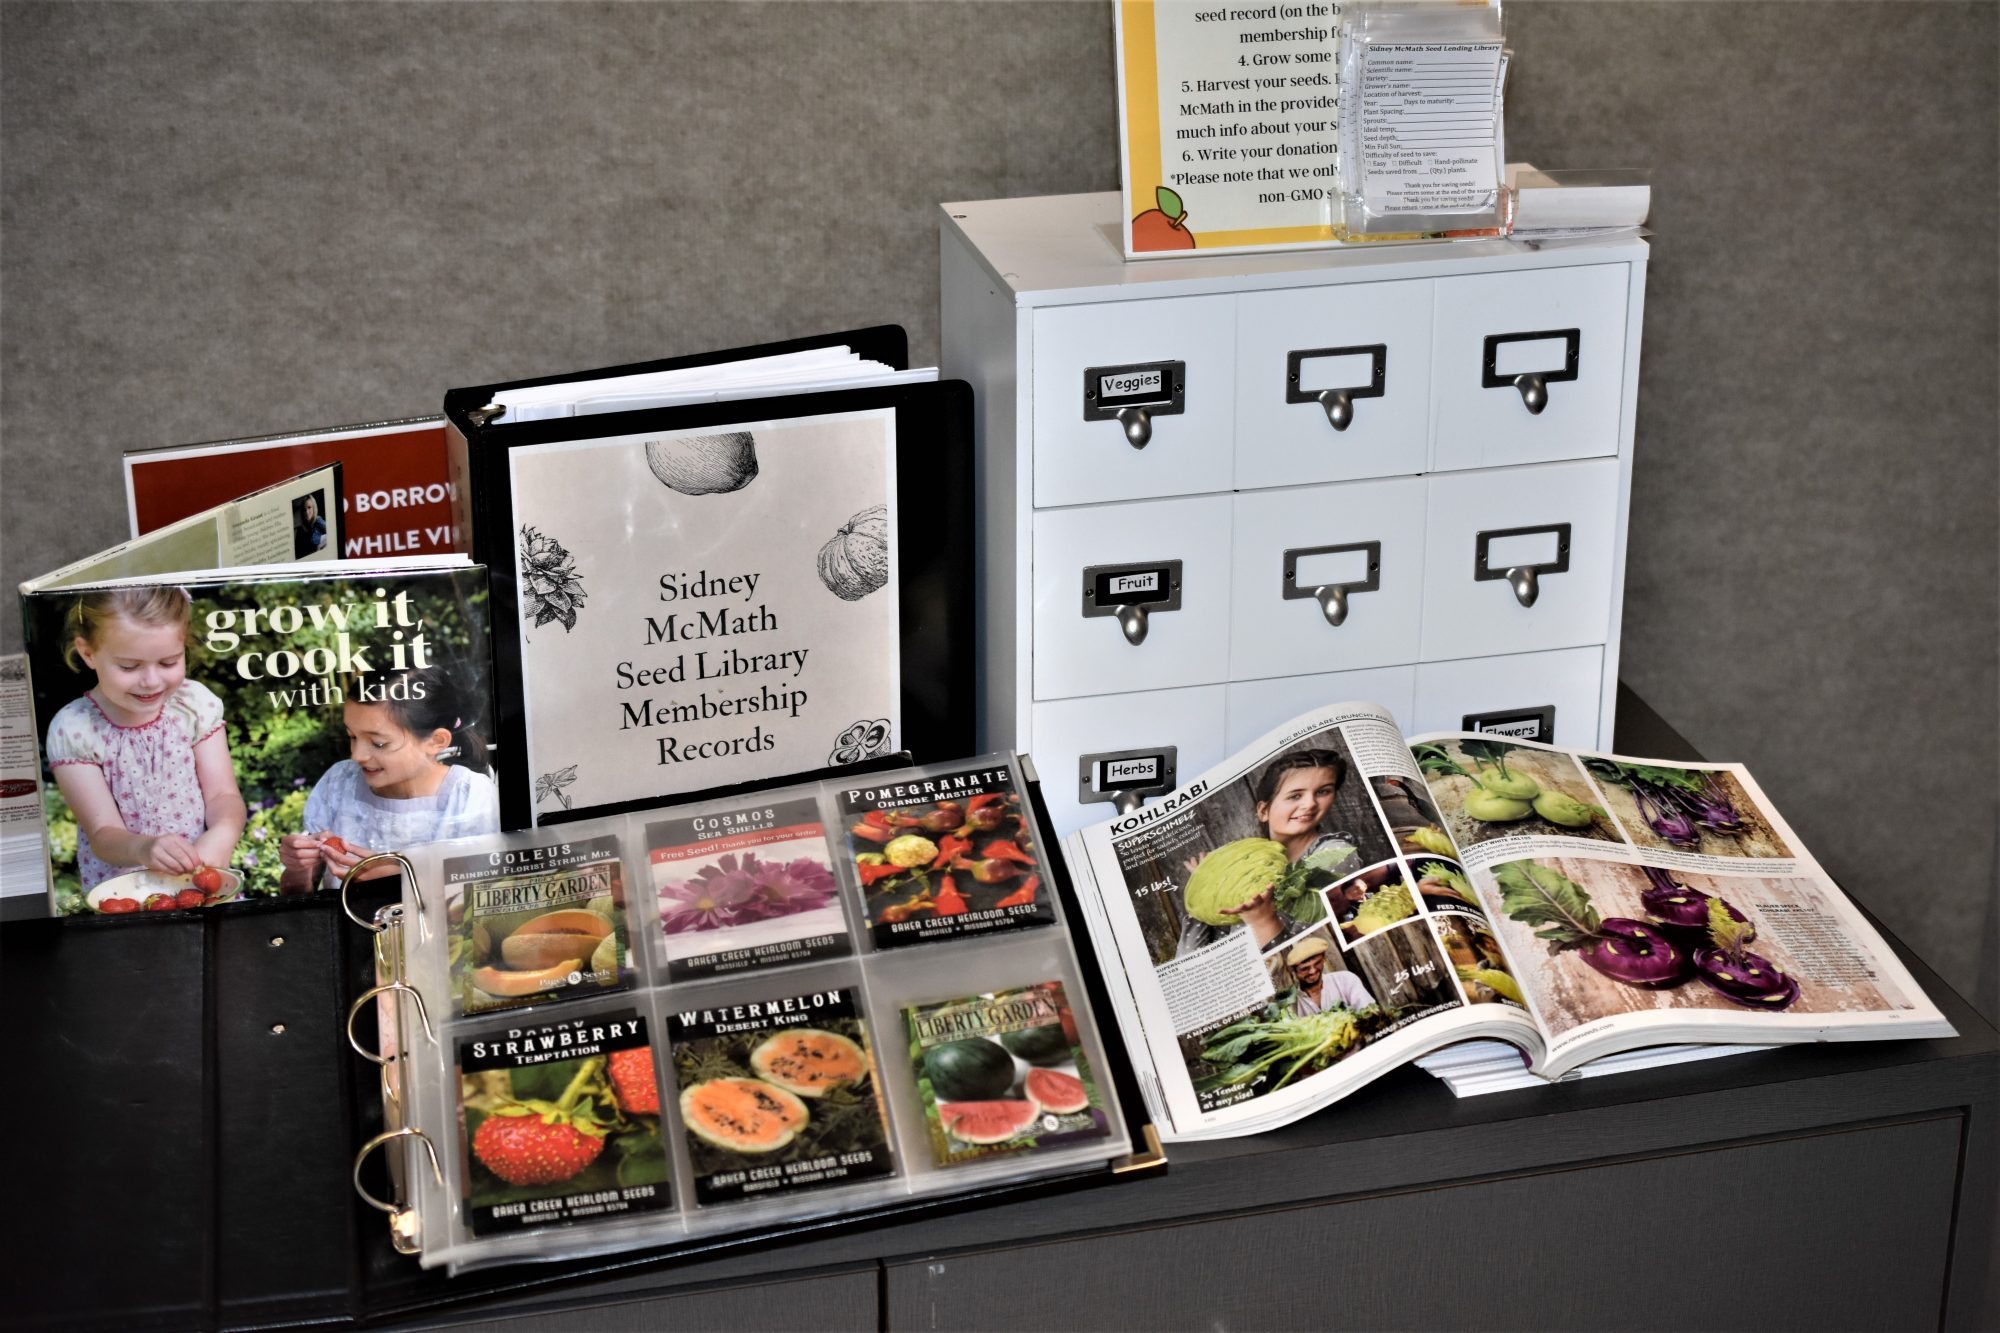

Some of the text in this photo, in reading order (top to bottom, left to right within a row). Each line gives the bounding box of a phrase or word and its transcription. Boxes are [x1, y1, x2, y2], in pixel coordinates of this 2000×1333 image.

[1195, 9, 1226, 22] seed
[1230, 6, 1277, 20] record
[1280, 5, 1302, 20] (on
[1306, 4, 1329, 16] the
[1240, 26, 1328, 43] membership
[1238, 54, 1250, 67] 4.
[1253, 52, 1291, 66] Grow
[1295, 51, 1331, 64] some
[1369, 45, 1393, 53] Sidney
[1443, 45, 1473, 53] Lending
[1473, 44, 1500, 53] Library
[1181, 80, 1193, 93] 5.
[1197, 77, 1251, 92] Harvest
[1254, 76, 1287, 95] your
[1290, 73, 1331, 87] seeds.
[1180, 101, 1234, 116] McMath
[1238, 99, 1251, 113] in
[1255, 98, 1277, 111] the
[1380, 108, 1405, 116] Spacing:
[1403, 98, 1418, 106] Days
[1426, 97, 1455, 105] maturity:
[1176, 124, 1216, 139] much
[1220, 123, 1247, 137] info
[1250, 120, 1290, 135] about
[1294, 120, 1327, 136] your
[1182, 142, 1338, 162] 6. Write your donation
[1365, 151, 1392, 159] Difficulty
[1372, 160, 1387, 168] Easy
[1434, 158, 1478, 166] Hand-pollinate
[1223, 169, 1254, 183] note
[1257, 167, 1285, 181] that
[1289, 167, 1309, 179] we
[1258, 188, 1323, 203] non-GMO
[1104, 374, 1160, 392] Veggies
[344, 529, 421, 558] WHILE
[660, 570, 760, 602] Sidney
[1118, 575, 1154, 591] Fruit
[205, 587, 424, 652] grow it,
[643, 604, 778, 646] McMath
[236, 630, 433, 680] cook it
[616, 648, 810, 690] Seed Library
[267, 673, 427, 709] with kids
[619, 683, 807, 730] Membership
[1279, 713, 1373, 745] BIG BULBS ARE CRUNCHY
[656, 725, 775, 765] Records
[1112, 762, 1155, 777] Herbs
[1110, 779, 1209, 836] KOHLRABI
[1117, 809, 1197, 852] SUPERSCHMELZ
[661, 829, 817, 861] Free Seed! Thank you for your order
[476, 883, 541, 909] LIBERTY
[545, 870, 611, 900] GARDEN
[1135, 885, 1149, 898] 15
[891, 903, 1038, 933] BAKER CREEK HEIRLOOM SEEDS
[1456, 904, 1469, 912] THE
[687, 935, 835, 968] BAKER CREEK HEIRLOOM SEEDS
[679, 989, 842, 1027] WATERMELON
[916, 1009, 985, 1039] LIBERTY
[988, 998, 1057, 1025] GARDEN
[473, 1020, 639, 1059] STRAWBERRY
[1193, 1022, 1221, 1037] MARVEL
[1200, 1083, 1246, 1101] So Tender
[1203, 1088, 1255, 1110] at any size!
[492, 1203, 527, 1218] BAKER
[530, 1199, 563, 1213] CREEK
[566, 1190, 619, 1207] HEIRLOOM
[623, 1185, 656, 1200] SEEDS
